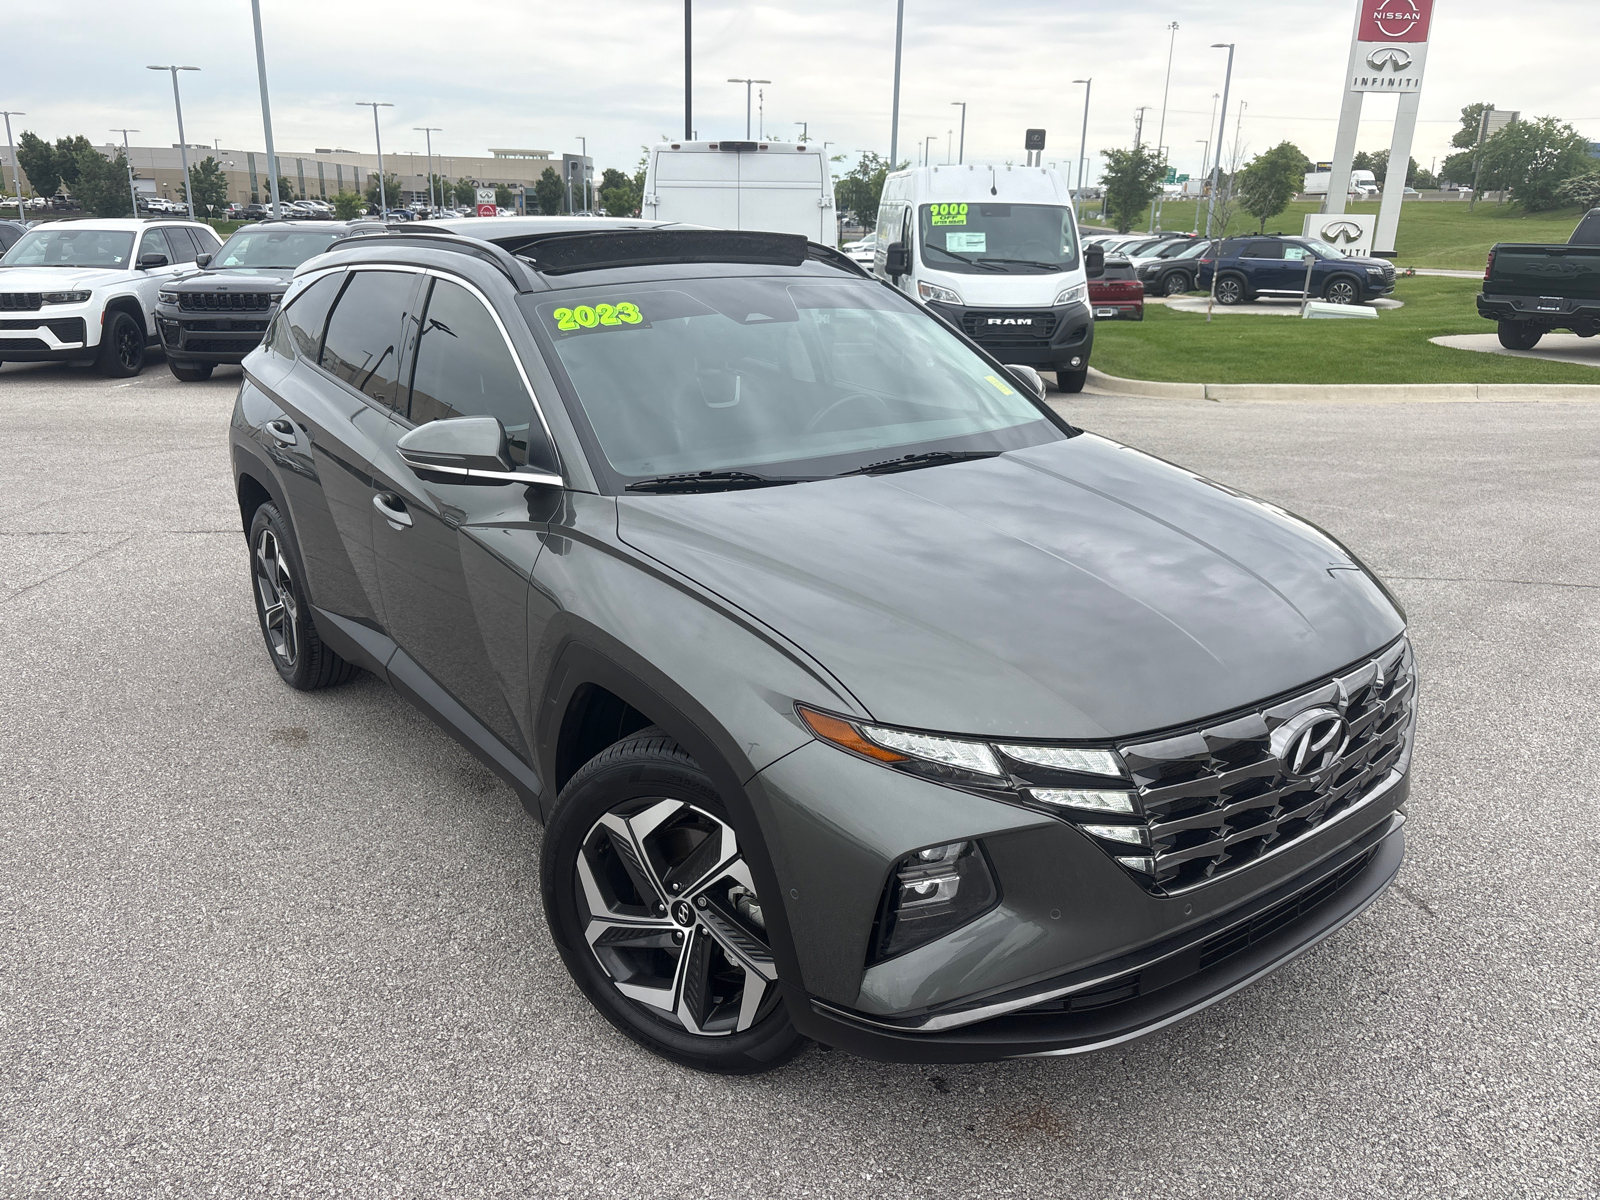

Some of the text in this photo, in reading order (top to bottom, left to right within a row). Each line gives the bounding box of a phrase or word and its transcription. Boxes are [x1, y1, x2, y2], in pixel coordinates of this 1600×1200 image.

[1373, 12, 1420, 20] NISSAN
[1353, 77, 1419, 87] INFINITI
[930, 203, 968, 215] 9000
[1524, 262, 1594, 273] RAM
[553, 302, 643, 331] 2023
